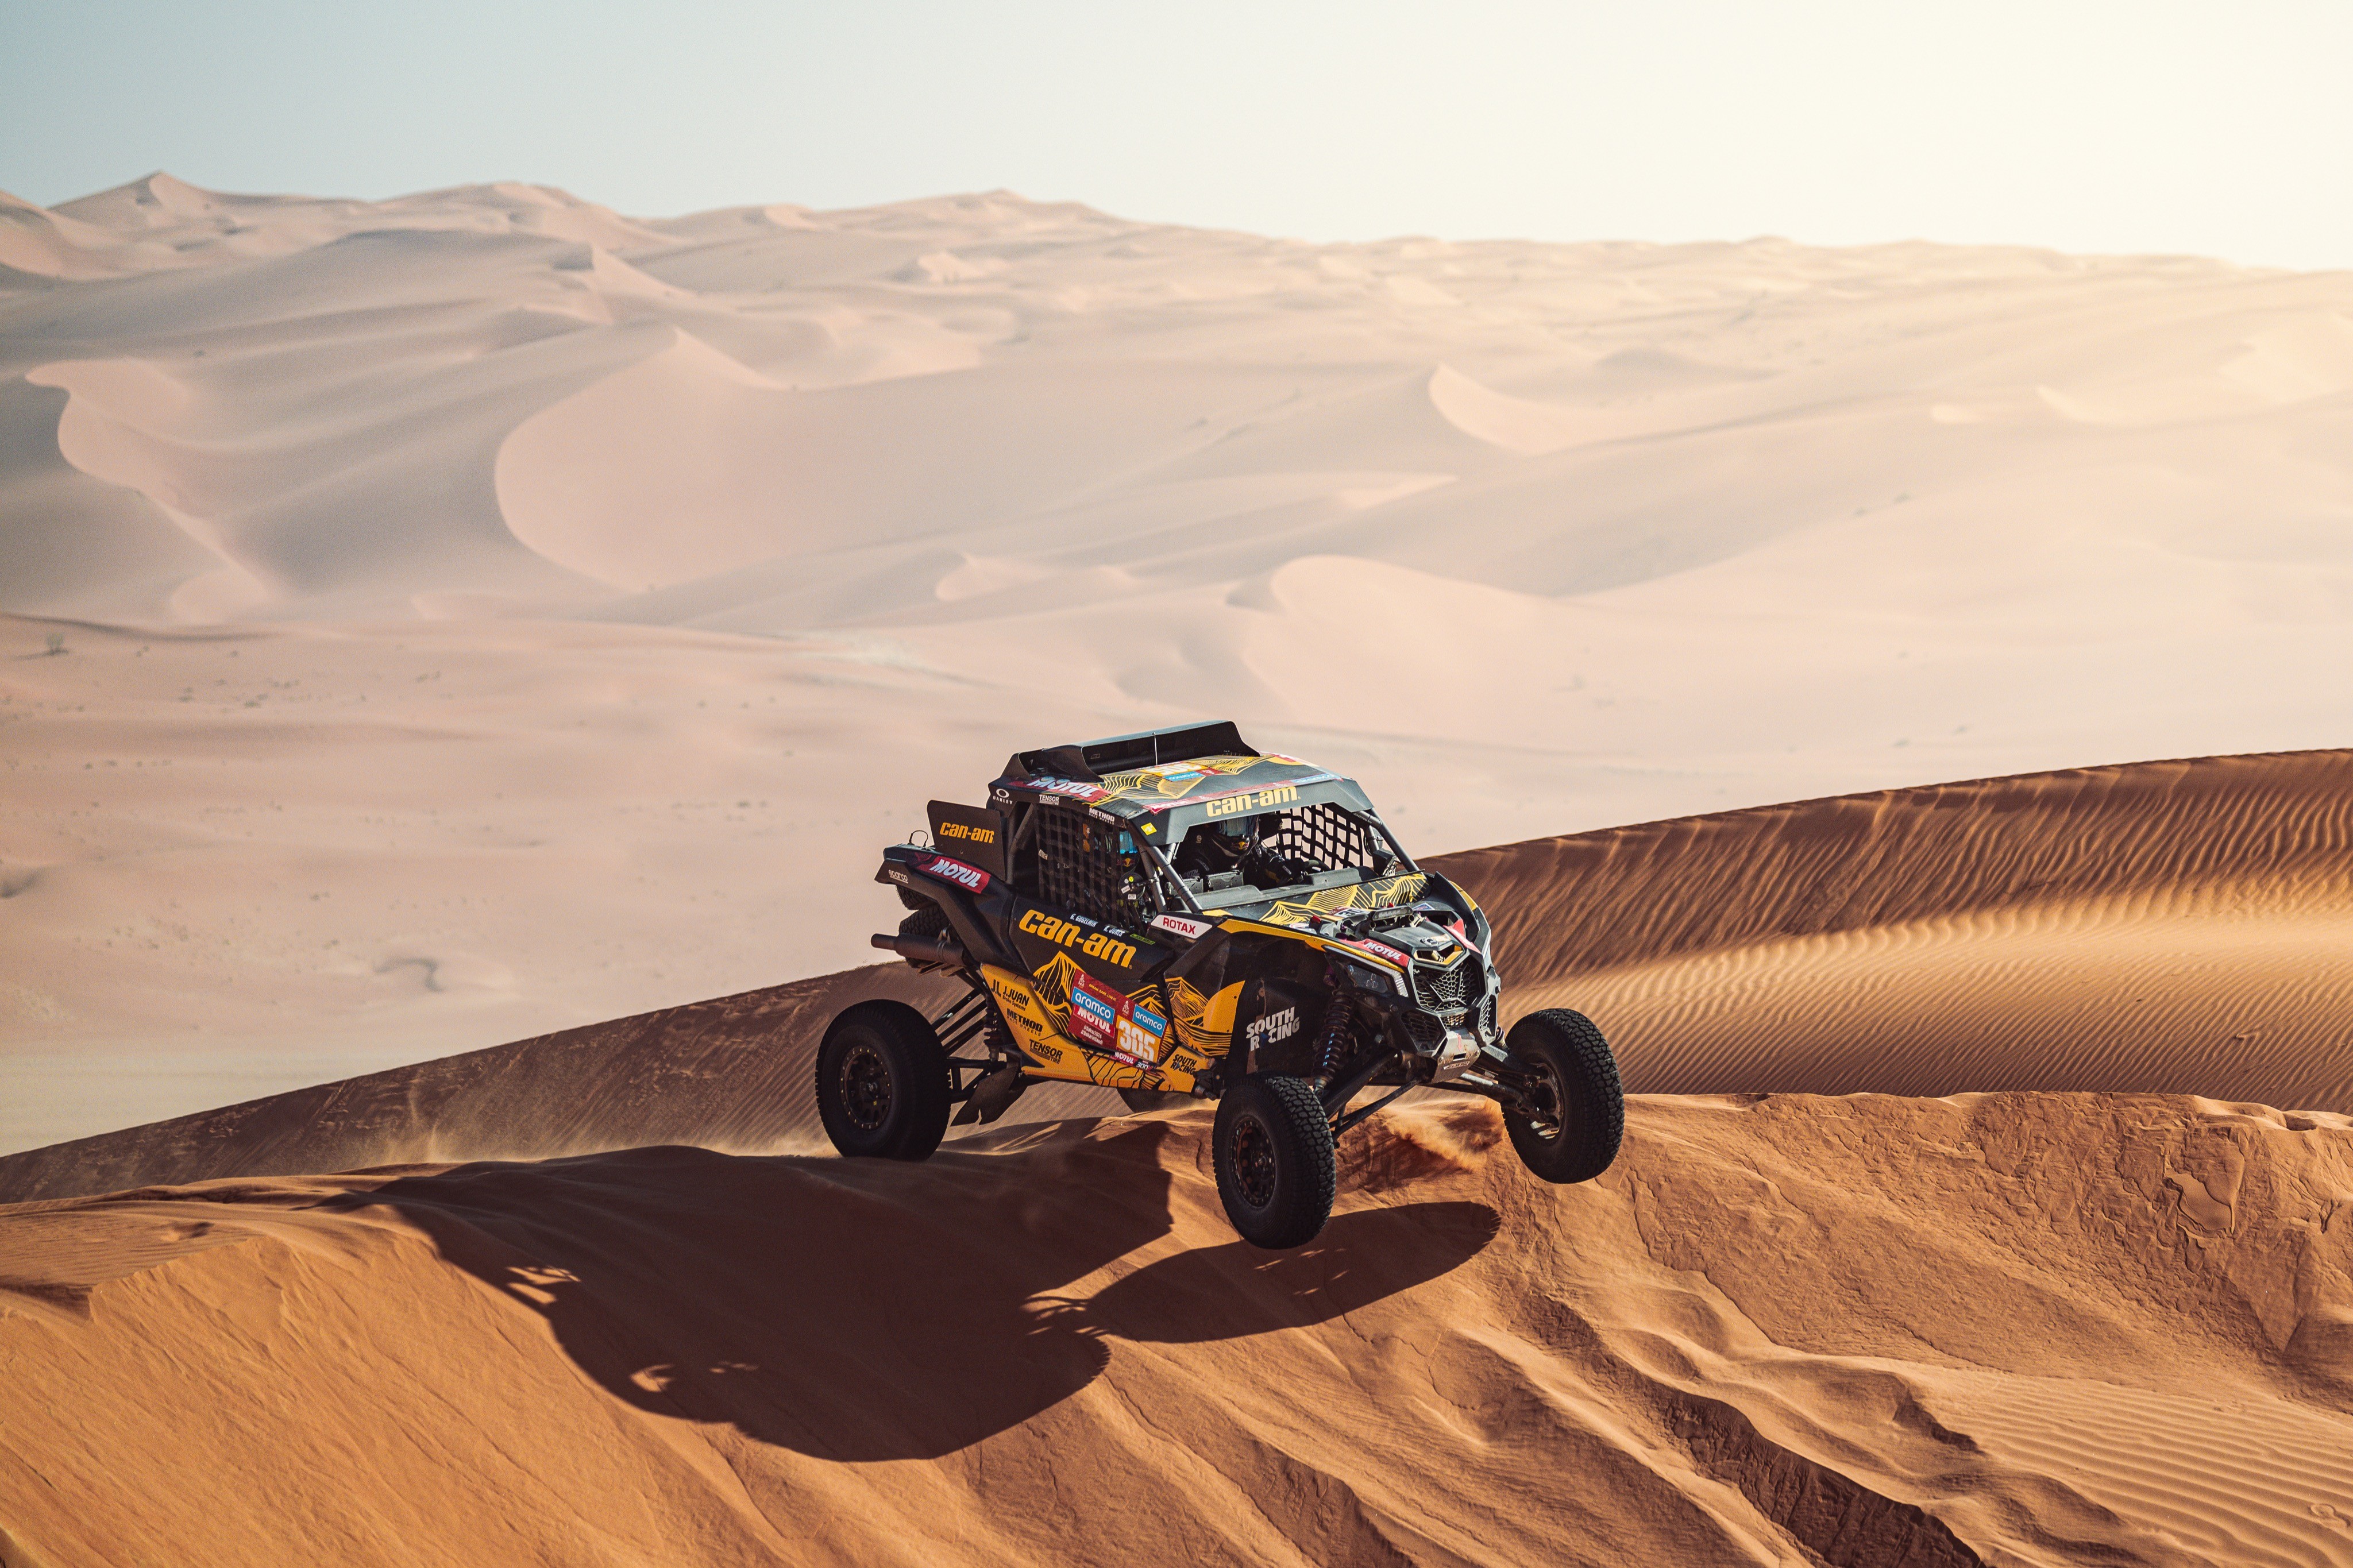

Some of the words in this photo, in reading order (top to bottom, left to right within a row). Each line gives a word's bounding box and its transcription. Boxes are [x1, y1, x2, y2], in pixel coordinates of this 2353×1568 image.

[1026, 776, 1098, 797] MOTUL
[993, 795, 1013, 805] OAKLEY
[1039, 794, 1060, 803] TENSOR
[1206, 786, 1298, 817] can-am
[1089, 808, 1115, 821] METHOD
[939, 822, 995, 844] can-am
[888, 870, 908, 882] sparco
[929, 859, 982, 887] MOTUL
[1162, 917, 1196, 935] ROTAX
[1019, 909, 1136, 968] can-am
[1364, 942, 1402, 960] MOTUL
[1012, 1001, 1026, 1011] Systems
[1075, 992, 1112, 1019] aramco
[1006, 1008, 1043, 1033] METHOD
[1077, 1007, 1111, 1033] MOTUL
[1135, 1011, 1163, 1030] aramco
[1246, 1006, 1295, 1039] SOUTH
[1020, 1023, 1041, 1037] WHEELS
[1029, 1038, 1063, 1059] TENSOR
[1119, 1020, 1155, 1063] 305
[1050, 1056, 1061, 1064] TIRE
[1114, 1051, 1135, 1065] MOTUL
[1172, 1054, 1198, 1067] SOUTH
